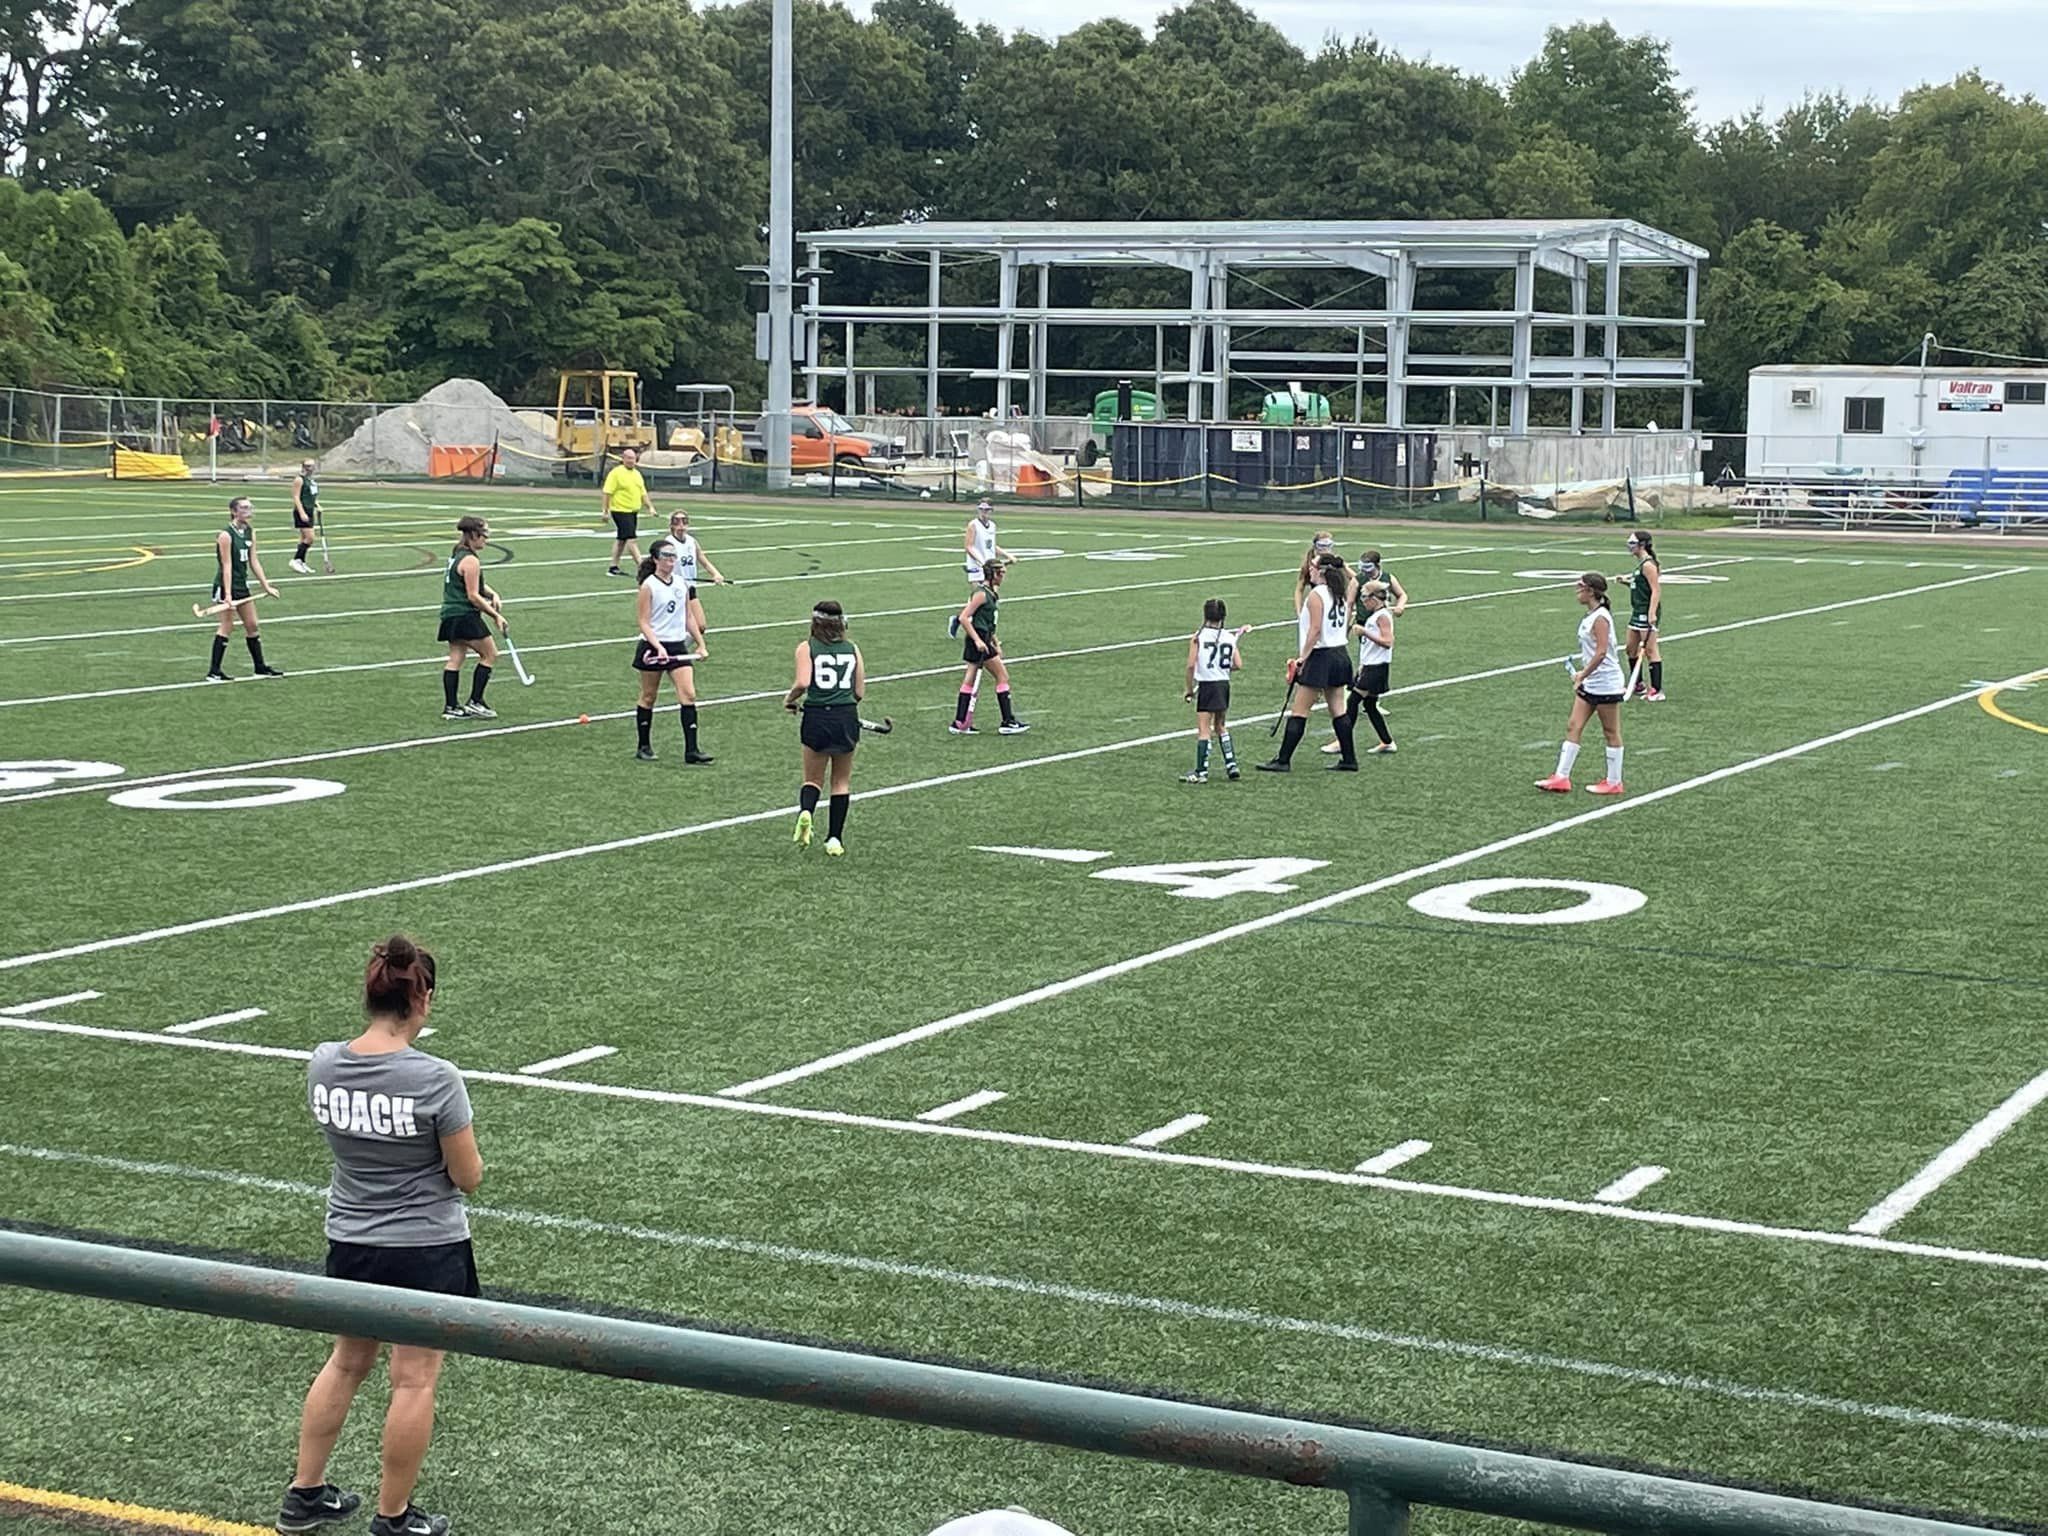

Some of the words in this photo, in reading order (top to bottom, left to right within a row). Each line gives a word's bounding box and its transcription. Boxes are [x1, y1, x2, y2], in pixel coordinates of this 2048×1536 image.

[681, 555, 694, 567] 92
[667, 601, 676, 613] 3
[1204, 641, 1233, 670] 78
[814, 653, 857, 690] 67
[313, 1083, 418, 1137] COACH
